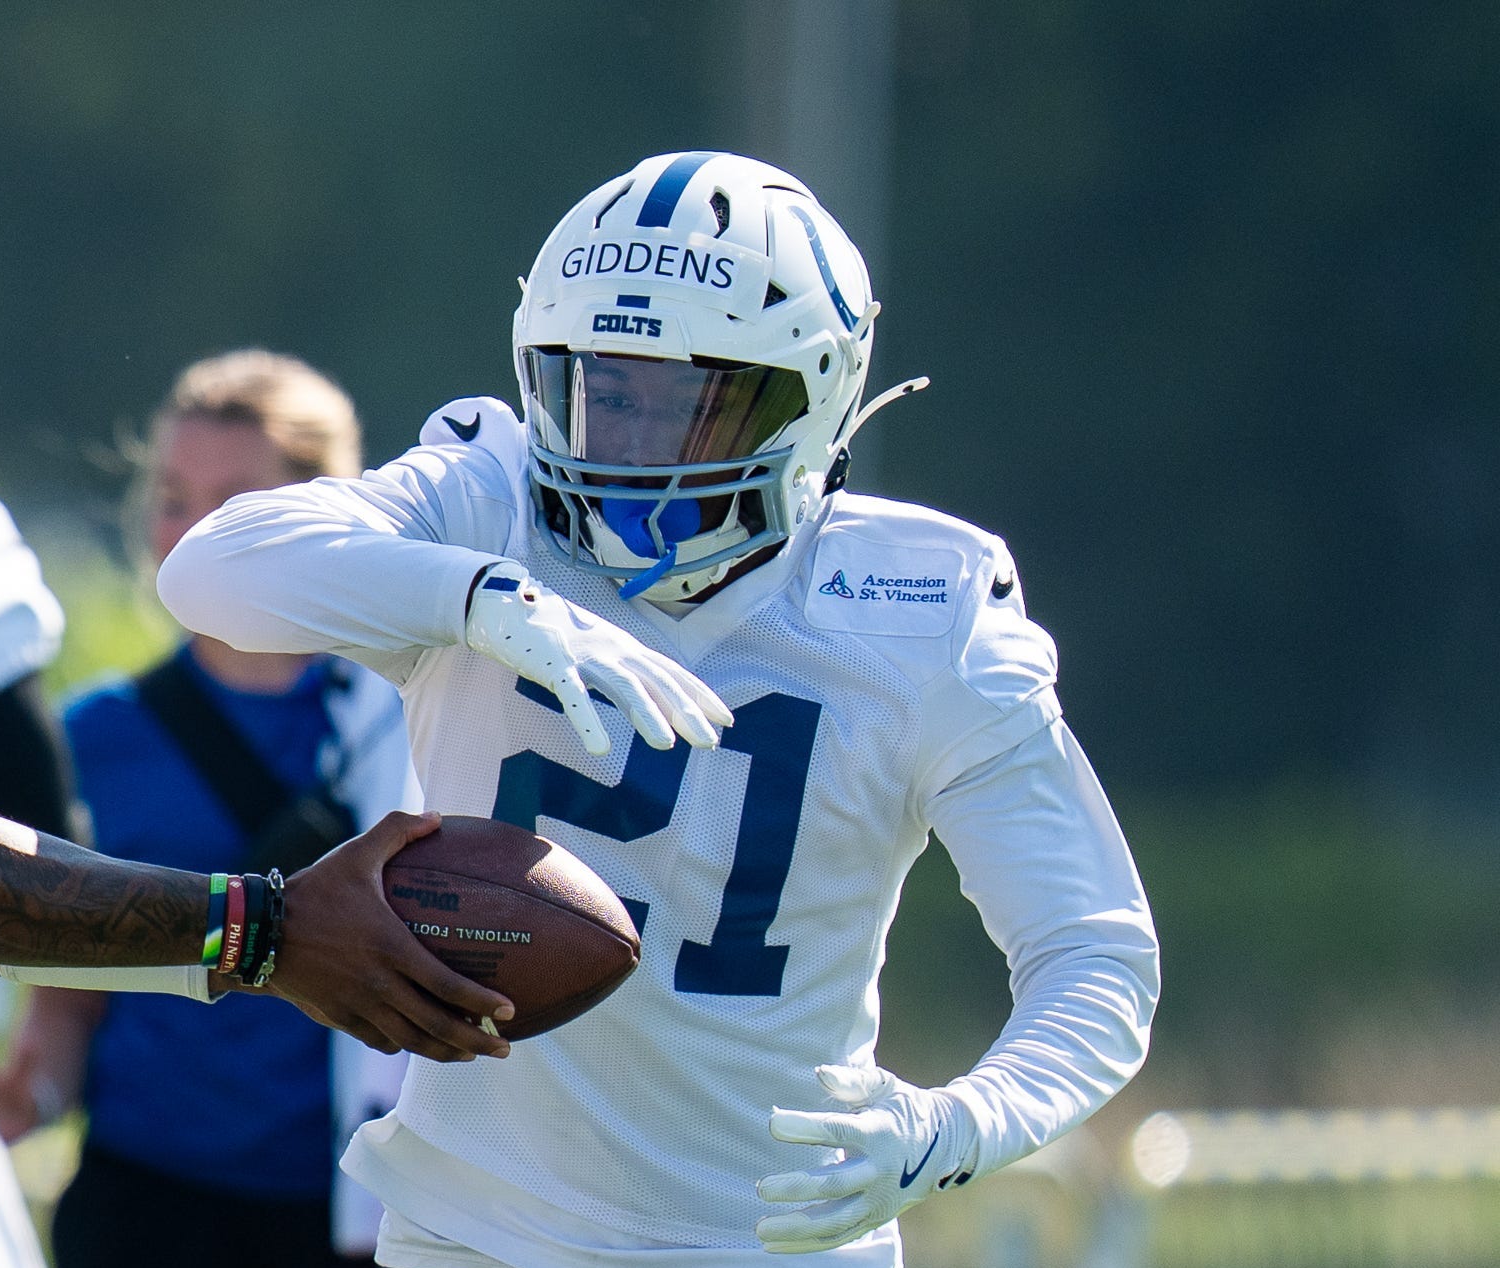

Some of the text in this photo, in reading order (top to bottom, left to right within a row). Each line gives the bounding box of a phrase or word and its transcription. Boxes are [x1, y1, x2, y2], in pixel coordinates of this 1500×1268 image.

[561, 242, 735, 289] GIDDENS
[592, 313, 663, 338] COLTS
[861, 574, 946, 588] Ascension
[858, 588, 948, 603] St. Vincent
[490, 675, 823, 997] 21
[229, 924, 241, 944] Phi
[404, 921, 531, 944] NATIONAL FOOT
[226, 946, 238, 960] Nu
